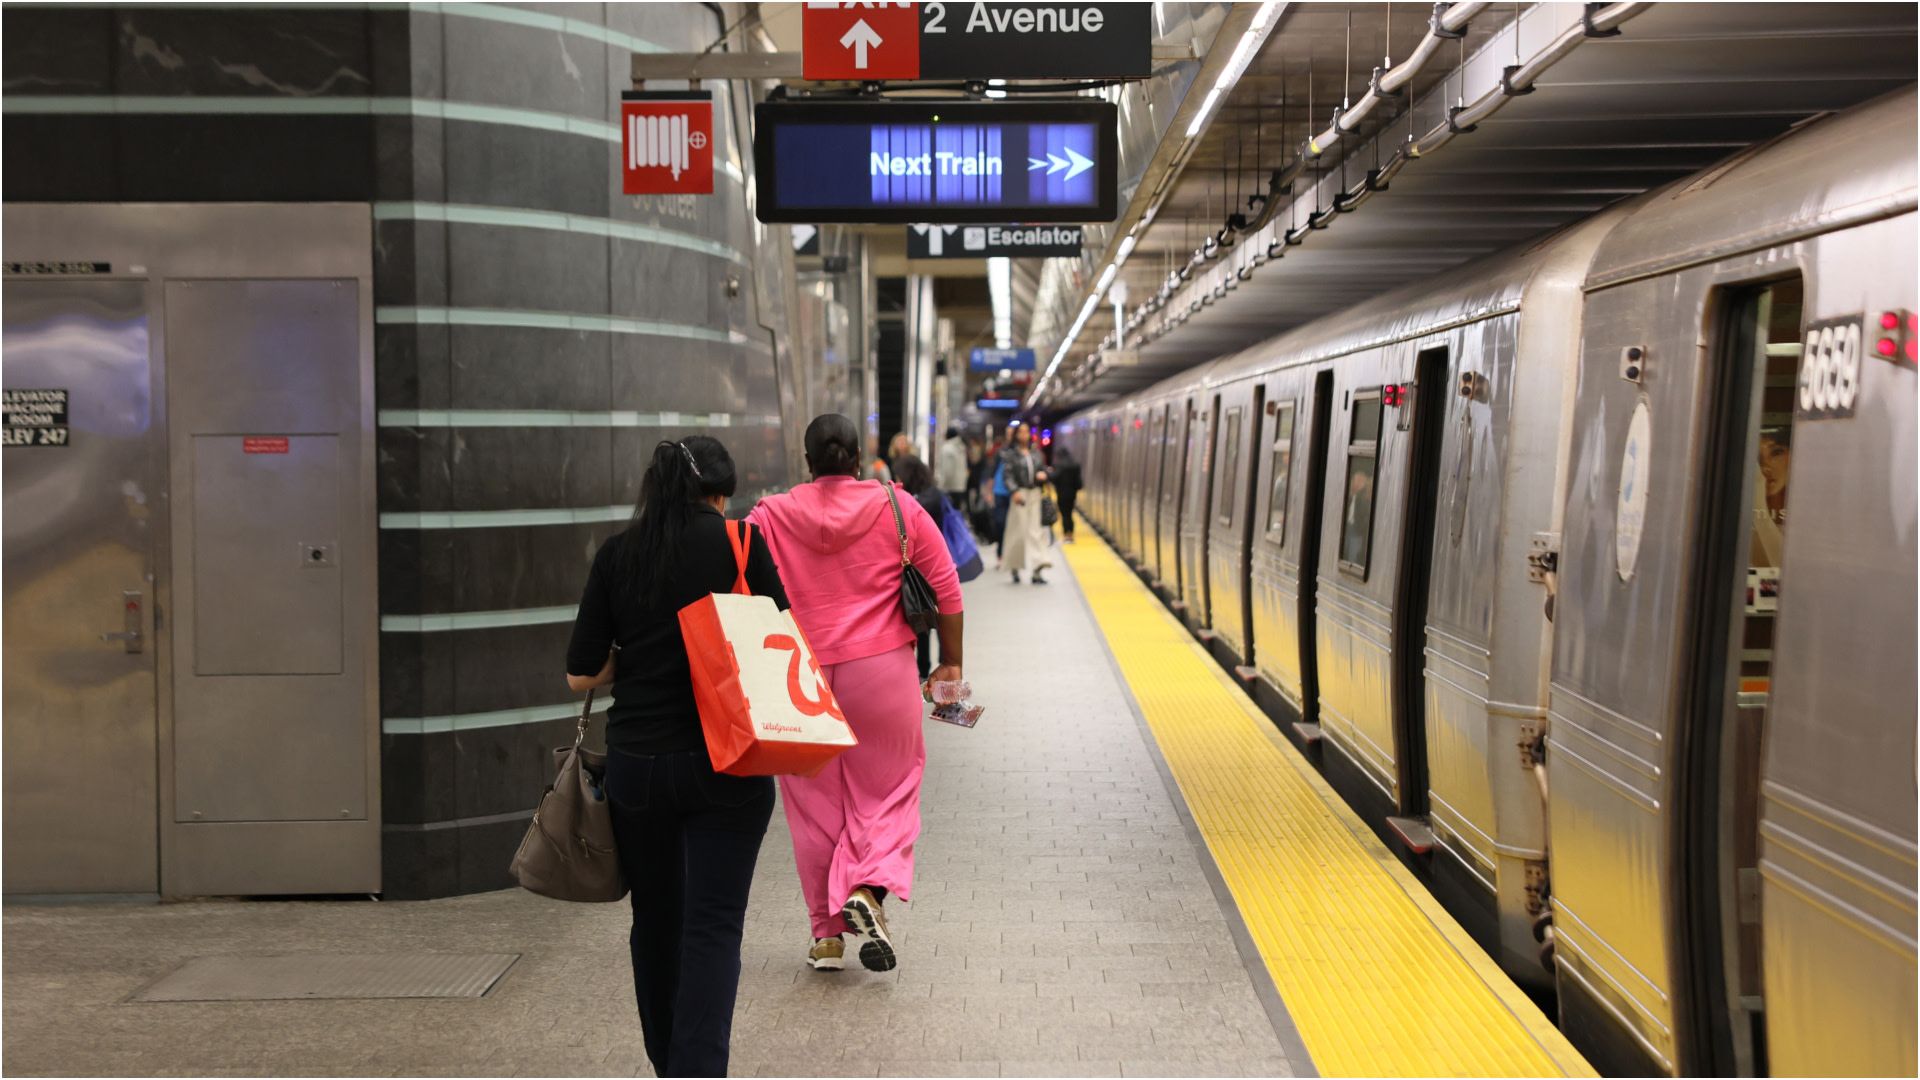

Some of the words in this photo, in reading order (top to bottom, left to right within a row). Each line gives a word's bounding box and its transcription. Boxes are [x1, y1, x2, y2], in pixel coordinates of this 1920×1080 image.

[924, 2, 946, 33] 2
[965, 7, 1104, 33] Avenue
[870, 152, 931, 175] Next
[935, 151, 1002, 175] Train
[988, 227, 1080, 245] Escalator
[1800, 323, 1860, 411] 5659
[9, 413, 54, 426] ROOM
[39, 428, 67, 444] 247
